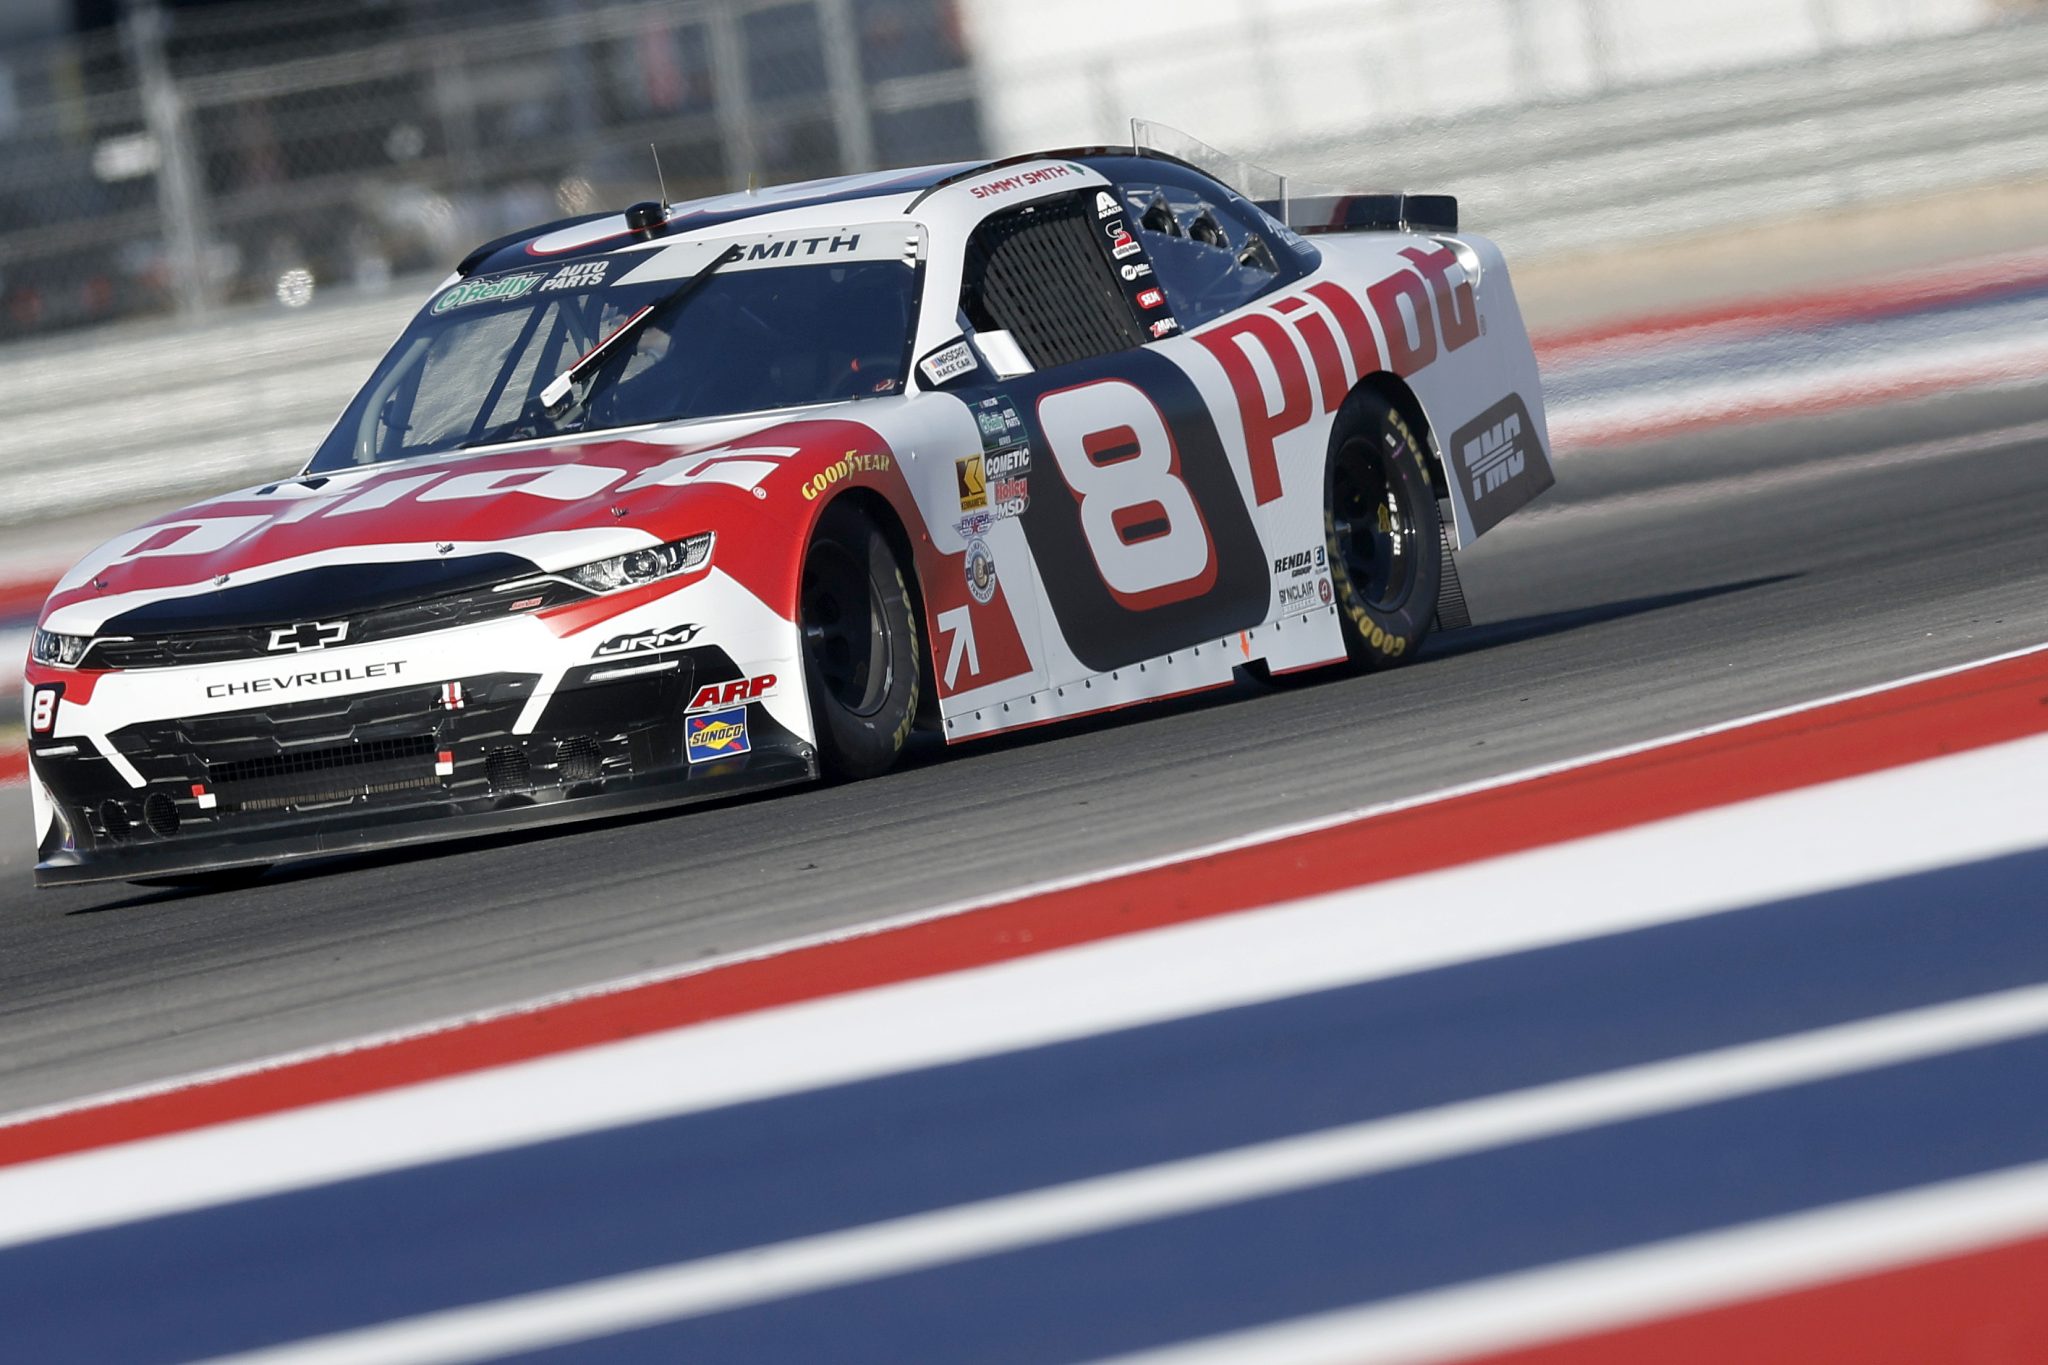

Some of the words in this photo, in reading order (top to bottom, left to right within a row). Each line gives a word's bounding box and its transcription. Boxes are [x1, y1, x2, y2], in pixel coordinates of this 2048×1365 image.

[970, 175, 1024, 199] SAMMY
[1022, 164, 1070, 185] SMITH
[538, 272, 606, 292] PARTS
[553, 260, 610, 280] AUTO
[436, 273, 546, 313] O'Reilly
[935, 363, 958, 379] RACE
[956, 357, 972, 371] CAR
[986, 447, 1030, 477] COMETIC
[1464, 412, 1525, 502] TMC
[801, 449, 890, 501] GOODYEAR
[997, 498, 1025, 520] MSD
[1036, 377, 1219, 612] 8
[1274, 550, 1312, 575] RENDA
[1291, 565, 1312, 578] GROUP
[1279, 580, 1315, 604] SINCLAIR
[598, 626, 694, 656] JRM
[206, 660, 408, 699] CHEVROLET
[688, 674, 778, 709] ARP
[32, 689, 56, 734] 8
[691, 725, 744, 745] SUNOCO
